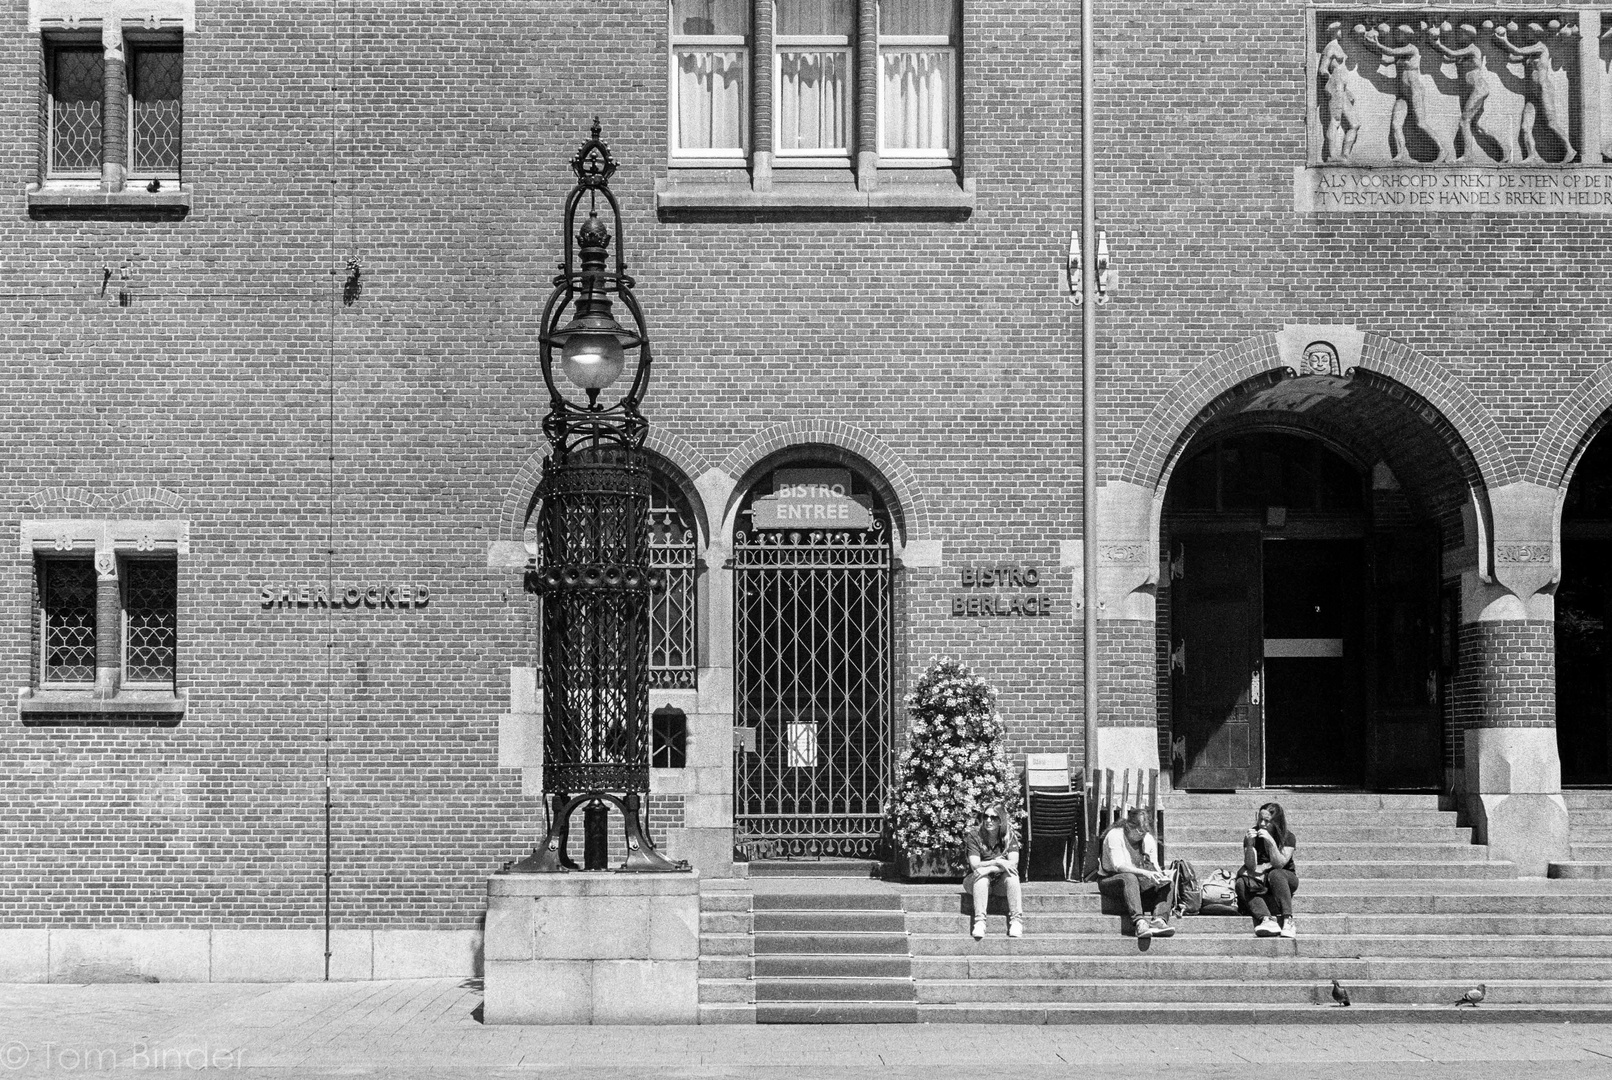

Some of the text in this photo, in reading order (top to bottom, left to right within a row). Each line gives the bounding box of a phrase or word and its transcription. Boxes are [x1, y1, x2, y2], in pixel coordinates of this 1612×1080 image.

[1319, 174, 1347, 188] ALS
[1351, 174, 1438, 188] VOORHOOFD
[1442, 174, 1494, 188] STREKT
[1499, 174, 1515, 188] DE
[1518, 174, 1559, 188] STEEN
[1562, 174, 1581, 188] OP
[1585, 174, 1602, 188] DE
[1332, 191, 1406, 205] VERSTAND
[1409, 191, 1435, 205] DES
[1439, 191, 1501, 205] HANDELS
[1505, 191, 1547, 205] BREKE
[1550, 191, 1564, 205] IN
[780, 483, 846, 498] BISTRO
[776, 504, 849, 519] ENTREE
[961, 567, 1040, 588] BISTRO
[260, 584, 430, 609] SHERLOCKED
[952, 595, 1051, 617] BERLAGE
